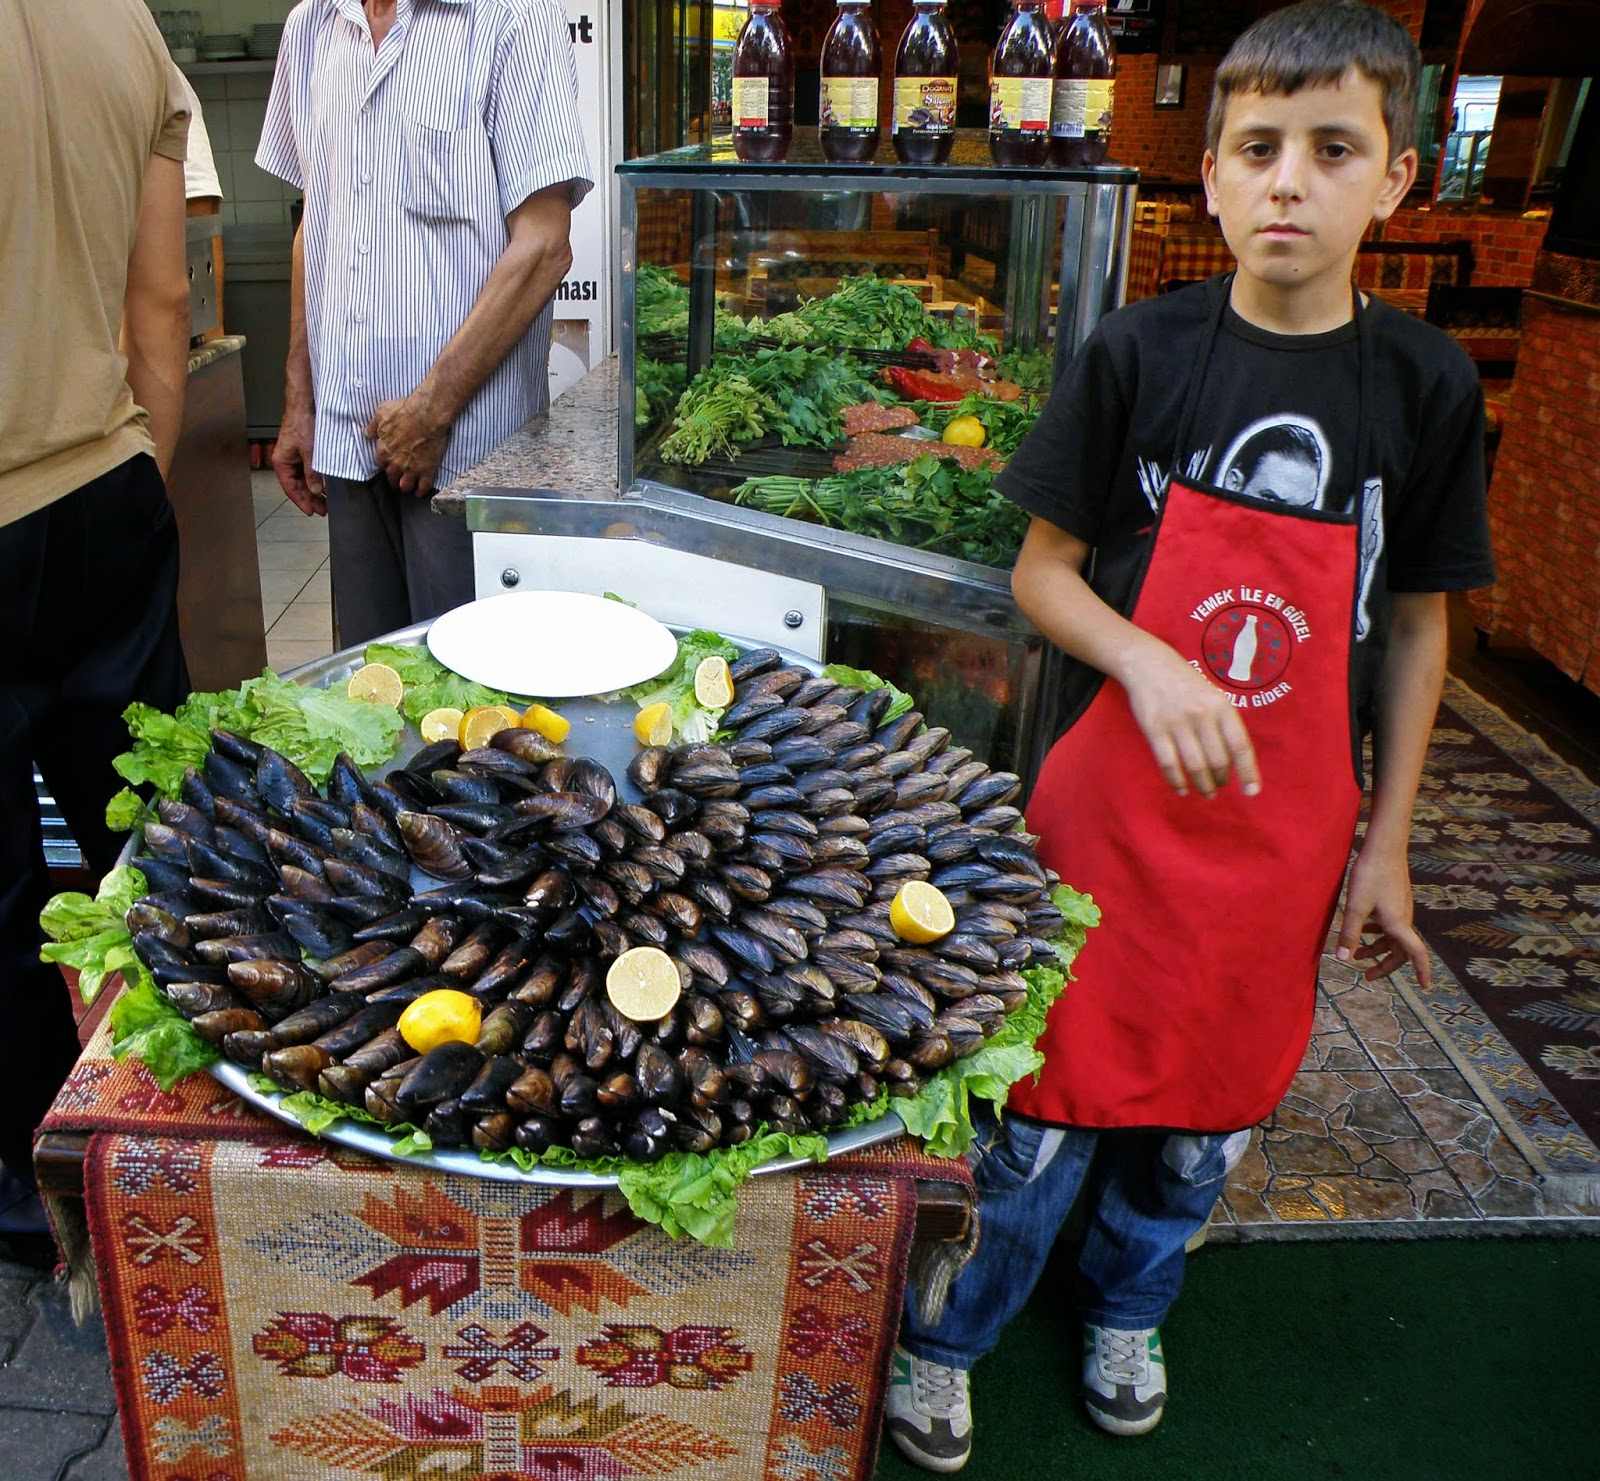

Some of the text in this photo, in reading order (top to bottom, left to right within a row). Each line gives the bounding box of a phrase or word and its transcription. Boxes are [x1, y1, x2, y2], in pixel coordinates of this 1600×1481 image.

[1190, 585, 1312, 643] YEMEK İLE EN GÜZEL
[1251, 681, 1293, 708] GİDER
